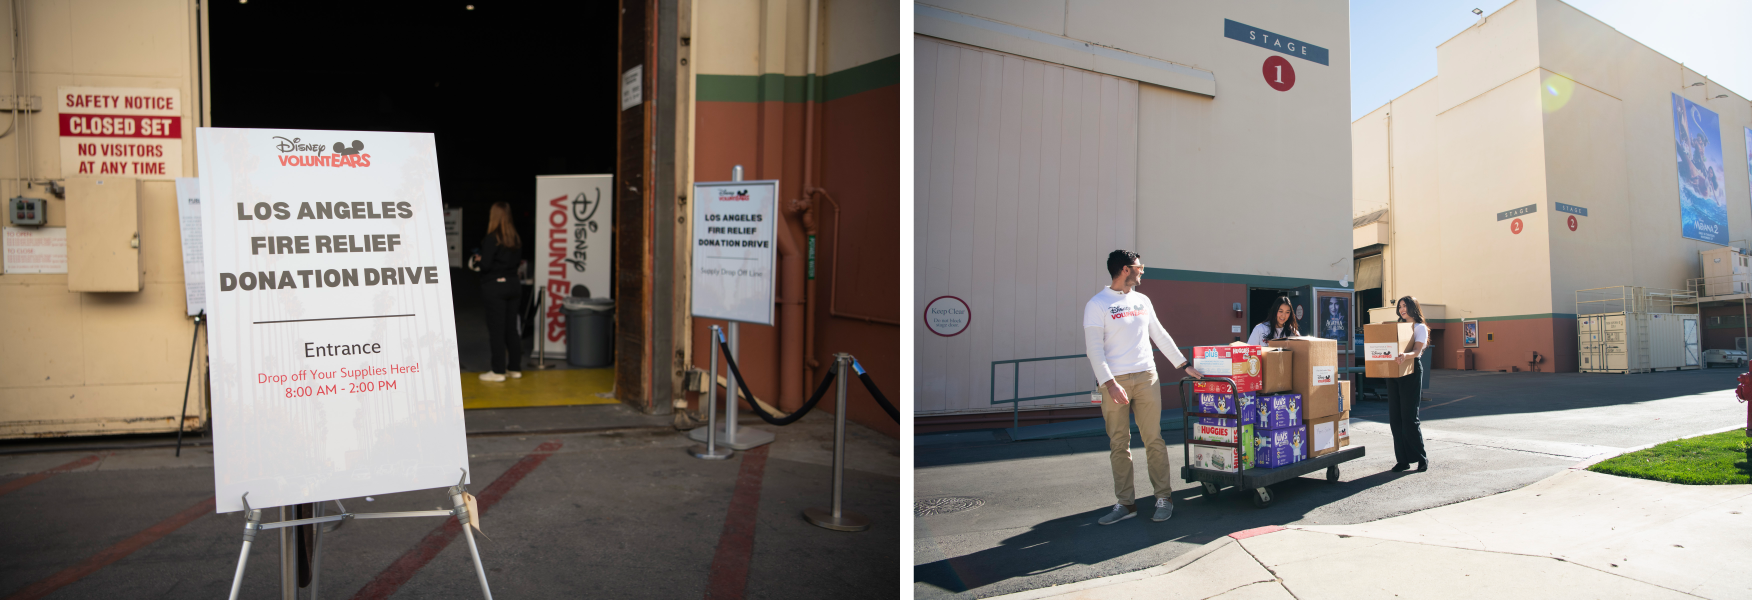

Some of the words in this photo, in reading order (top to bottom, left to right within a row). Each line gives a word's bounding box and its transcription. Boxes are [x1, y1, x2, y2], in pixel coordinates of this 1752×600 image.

[1249, 30, 1307, 55] STAGE
[1273, 65, 1284, 84] 1
[66, 94, 119, 108] SAFETY
[124, 96, 173, 110] NOTICE
[69, 116, 135, 135] CLOSED
[141, 118, 172, 136] SET
[78, 143, 97, 157] NO
[100, 144, 163, 158] VISITORS
[272, 136, 326, 157] Disney
[78, 161, 95, 174] AT
[100, 161, 128, 175] ANY
[132, 162, 166, 175] TIME
[237, 202, 291, 221] LOS
[297, 201, 413, 220] ANGELES
[1504, 208, 1528, 218] STAGE
[1562, 204, 1582, 214] STAGE
[722, 214, 763, 222] ANGELES
[1570, 219, 1574, 228] 2
[565, 187, 600, 272] Disney
[1514, 222, 1520, 231] 2
[1714, 224, 1719, 234] 2
[251, 235, 310, 255] FIRE
[315, 233, 402, 254] RELIEF
[698, 239, 740, 247] DONATION
[742, 240, 769, 248] DRIVE
[220, 268, 359, 292] DONATION
[364, 266, 439, 286] DRIVE
[700, 266, 720, 276] Supply
[721, 268, 736, 276] Drop
[304, 342, 381, 358] Entrance
[258, 373, 288, 385] Drop
[291, 370, 307, 382] off
[309, 369, 337, 380] Your
[340, 365, 387, 380] Supplies
[390, 363, 420, 375] Here!
[285, 386, 313, 398] 8:00
[316, 384, 337, 396] AM
[349, 381, 374, 394] 2:00
[378, 380, 397, 392] PM
[1201, 426, 1228, 436] HUGGIES
